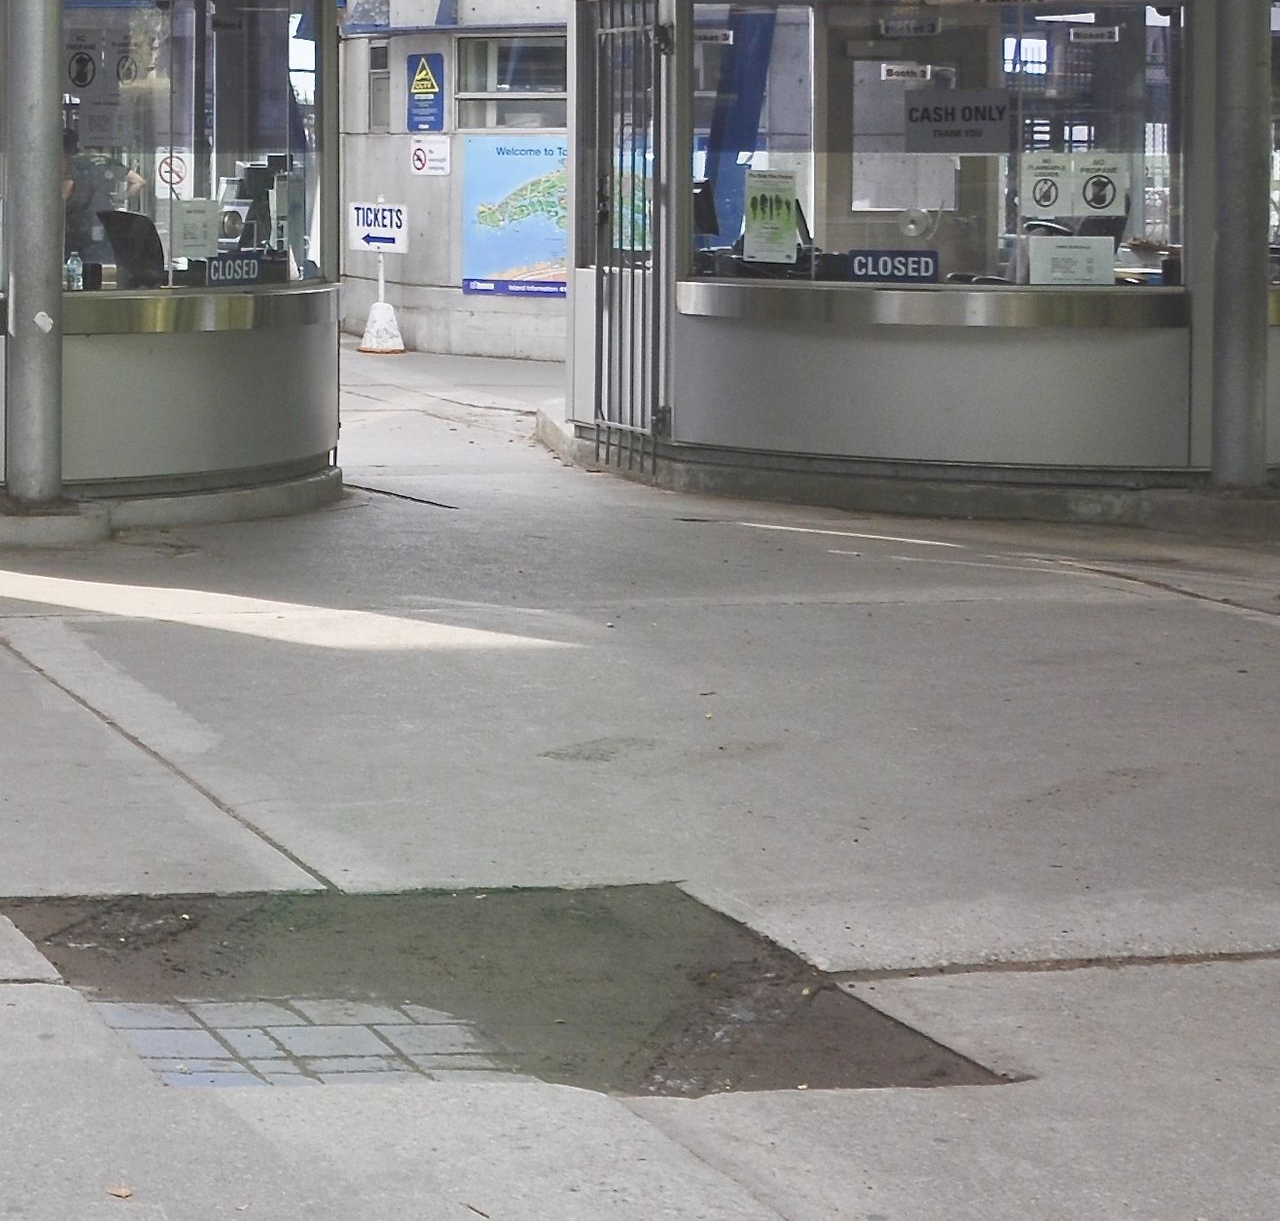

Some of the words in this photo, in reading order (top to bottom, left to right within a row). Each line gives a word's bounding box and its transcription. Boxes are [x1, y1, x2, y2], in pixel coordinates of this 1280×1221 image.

[886, 68, 918, 78] Booth
[920, 69, 927, 79] 2
[908, 106, 956, 123] CASH
[961, 105, 1007, 122] ONLY
[933, 129, 962, 138] THANK
[964, 128, 983, 138] YOU
[496, 147, 542, 157] Welcome
[544, 147, 554, 156] to
[557, 147, 568, 157] To
[354, 206, 403, 230] TICKETS
[210, 259, 259, 280] CLOSED
[852, 256, 934, 277] CLOSED
